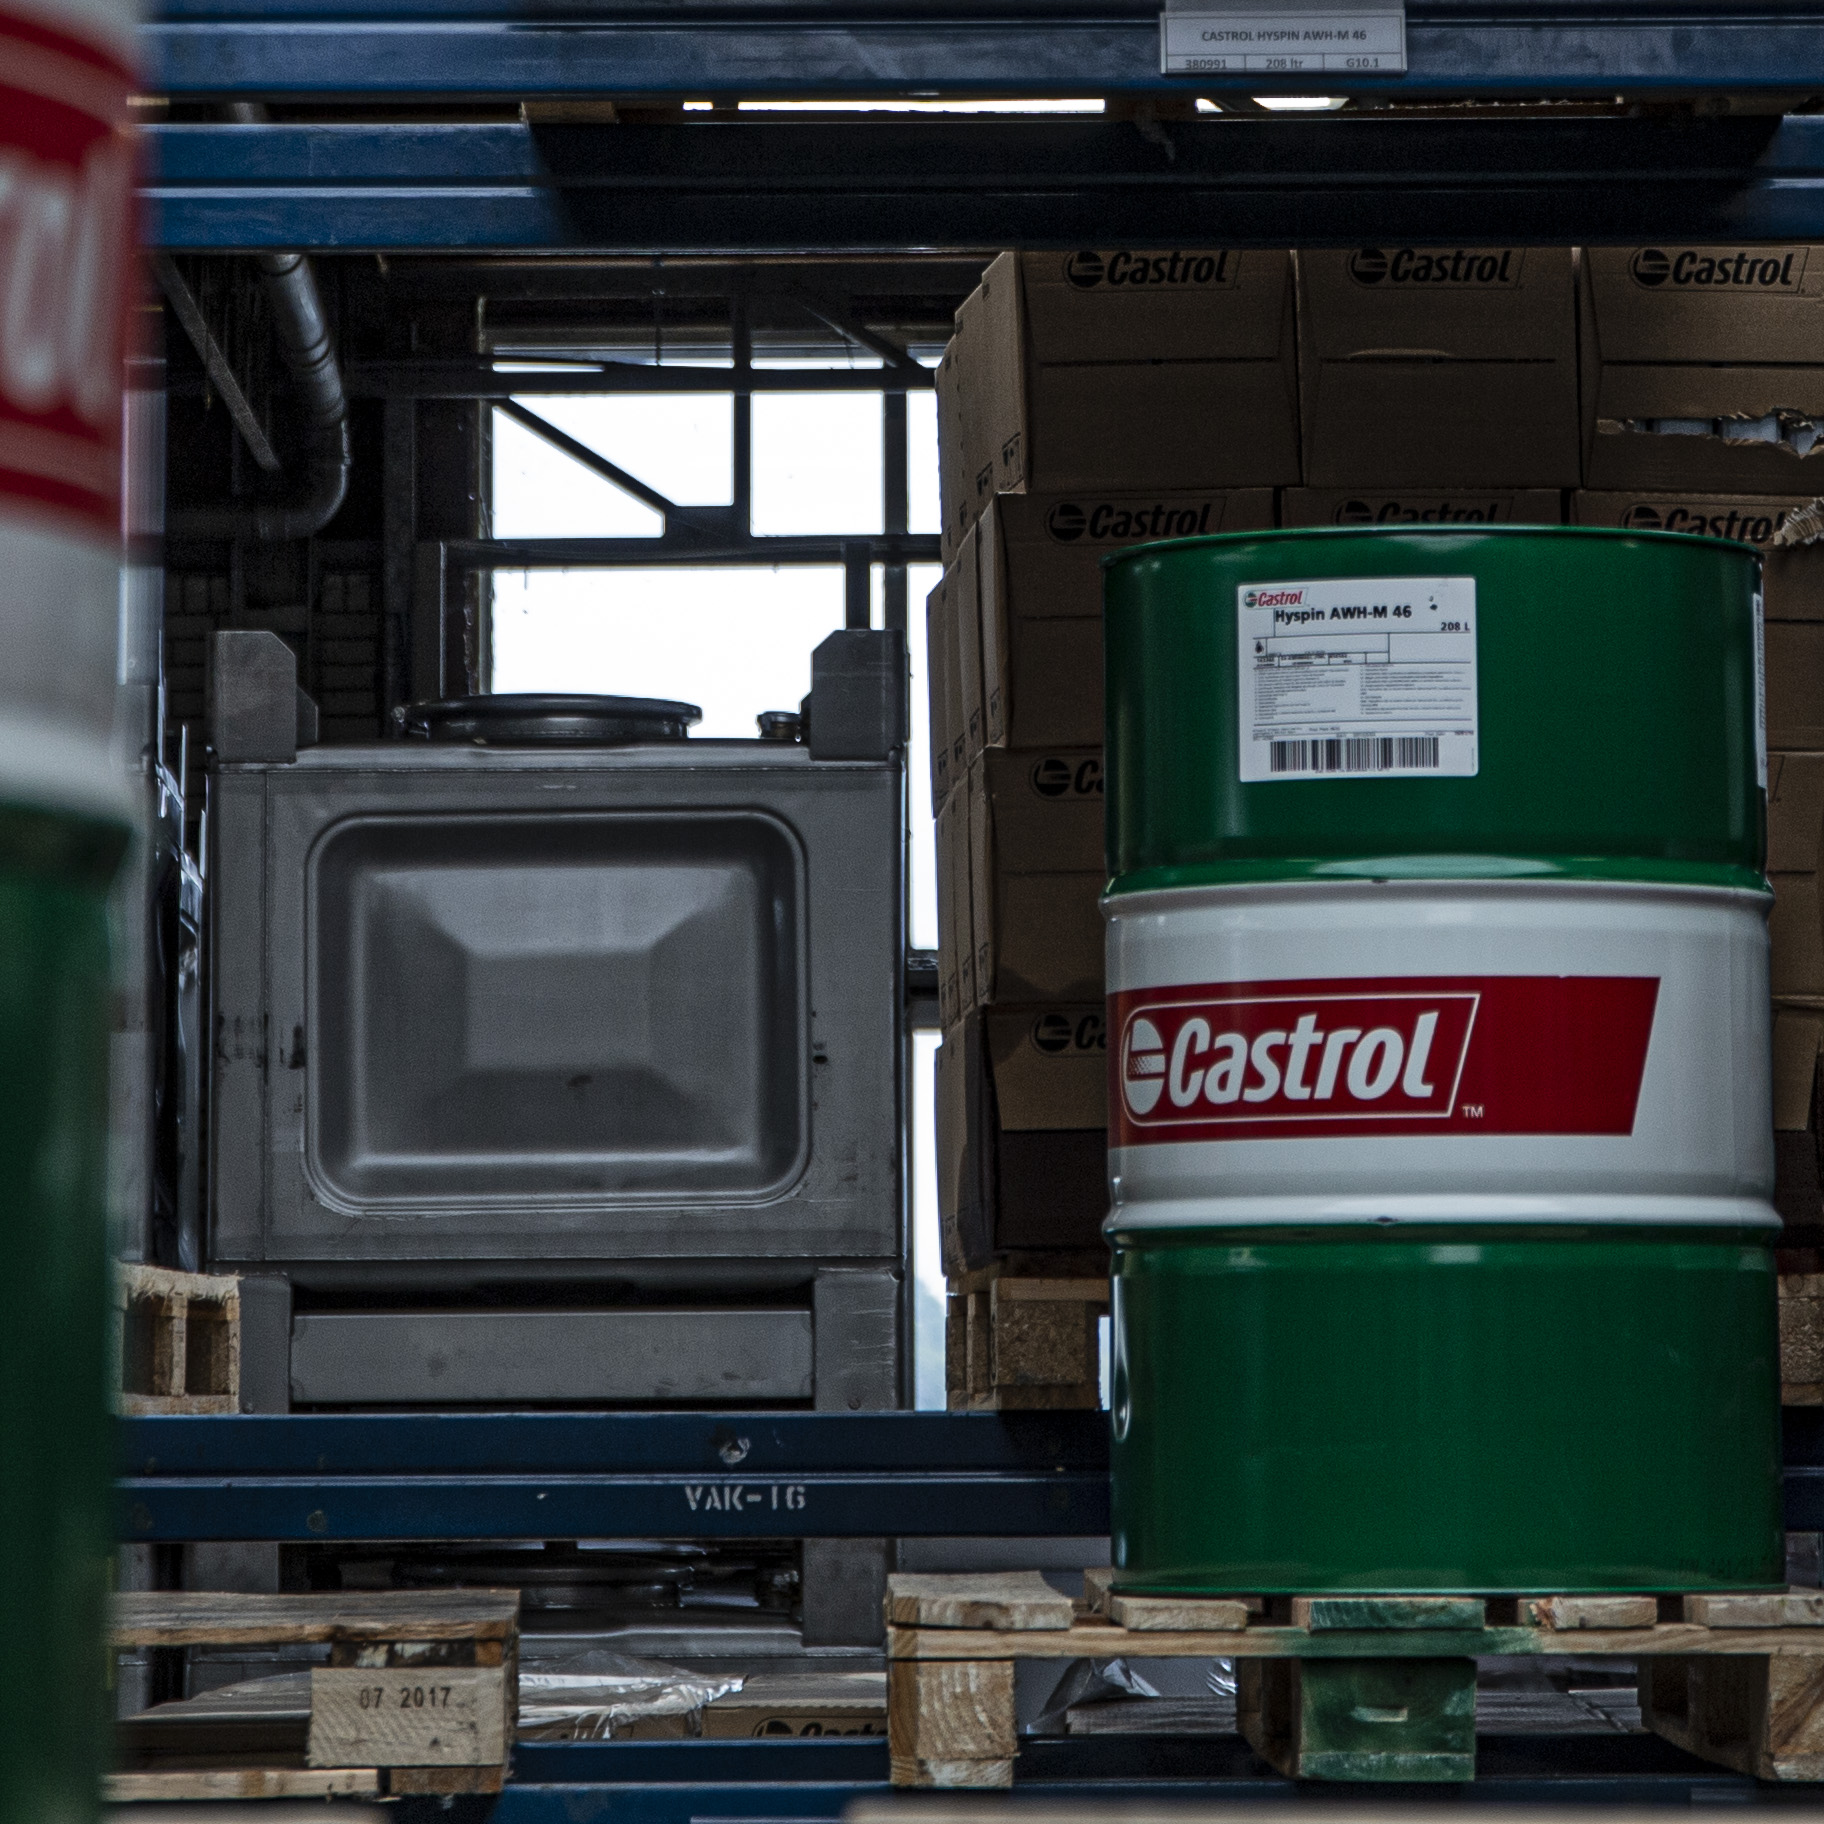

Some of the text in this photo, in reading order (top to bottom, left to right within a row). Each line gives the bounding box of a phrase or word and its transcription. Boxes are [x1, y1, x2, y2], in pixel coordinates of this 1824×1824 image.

[1201, 29, 1367, 42] CASTROL HYSPIN AWH-M 46
[1185, 57, 1379, 70] 380991 208 ltr G10.1
[1107, 250, 1228, 286] Castrol
[1390, 249, 1512, 283] Castrol
[1672, 250, 1794, 286] Castrol
[1089, 504, 1212, 539] Castrol
[1257, 590, 1303, 608] Castrol
[1275, 604, 1412, 625] Hyspin AWH-M 46
[1441, 622, 1471, 632] 208 L
[1169, 1011, 1440, 1108] Castrol
[359, 1685, 452, 1710] 07 2017
